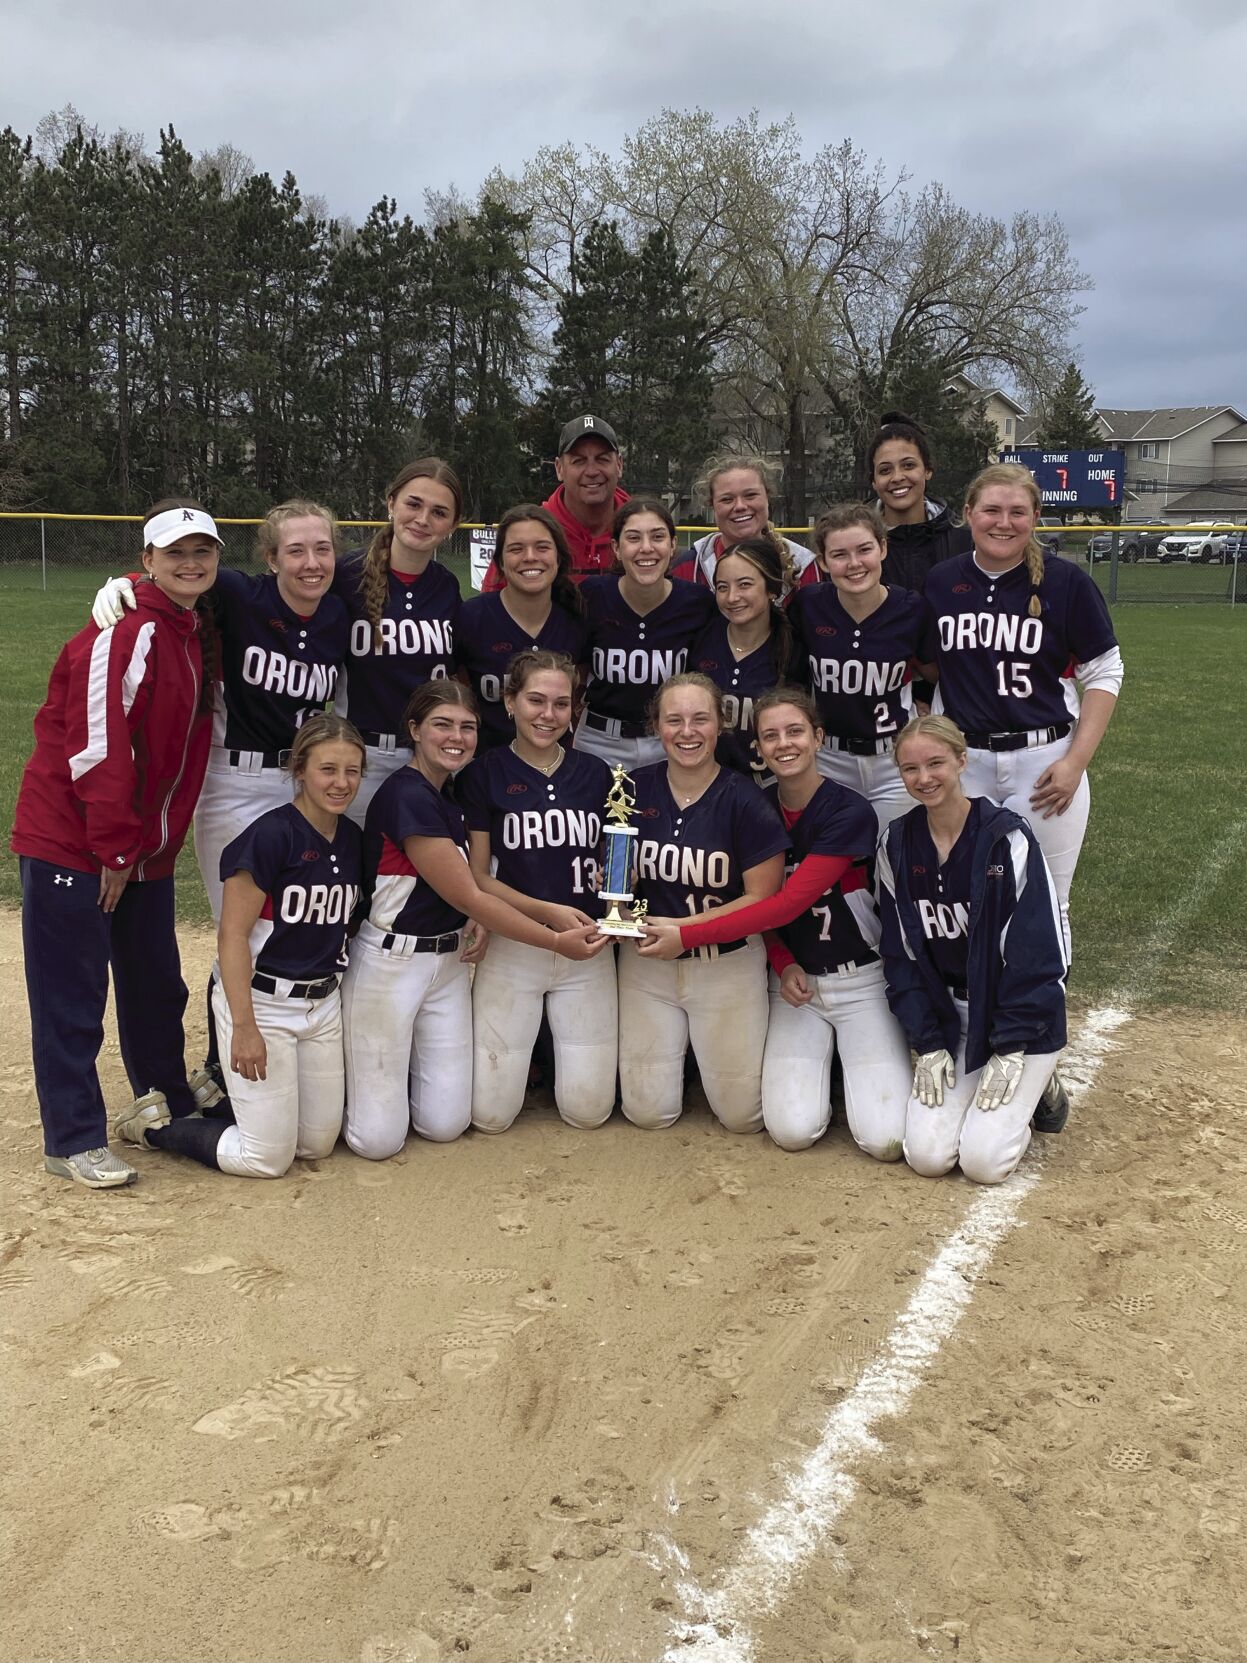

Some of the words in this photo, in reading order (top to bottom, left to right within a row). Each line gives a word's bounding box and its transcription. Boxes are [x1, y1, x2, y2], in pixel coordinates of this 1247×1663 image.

[1004, 455, 1021, 463] BALL
[1042, 454, 1069, 463] STRIKE
[1088, 454, 1104, 463] OUT
[1088, 469, 1116, 481] HOME
[1042, 490, 1078, 502] INNING
[1056, 468, 1068, 489] 7
[1104, 481, 1116, 500] 7
[472, 529, 497, 540] BULL
[938, 612, 1043, 655] ORONO
[592, 646, 688, 685] ORONO
[808, 654, 907, 696] ORONO
[996, 660, 1033, 698] 15
[873, 702, 897, 733] 2
[503, 808, 601, 850] ORONO
[571, 856, 598, 894] 13
[280, 884, 359, 925] ORON
[632, 898, 649, 912] 23
[914, 899, 971, 940] RON
[811, 905, 832, 941] 7
